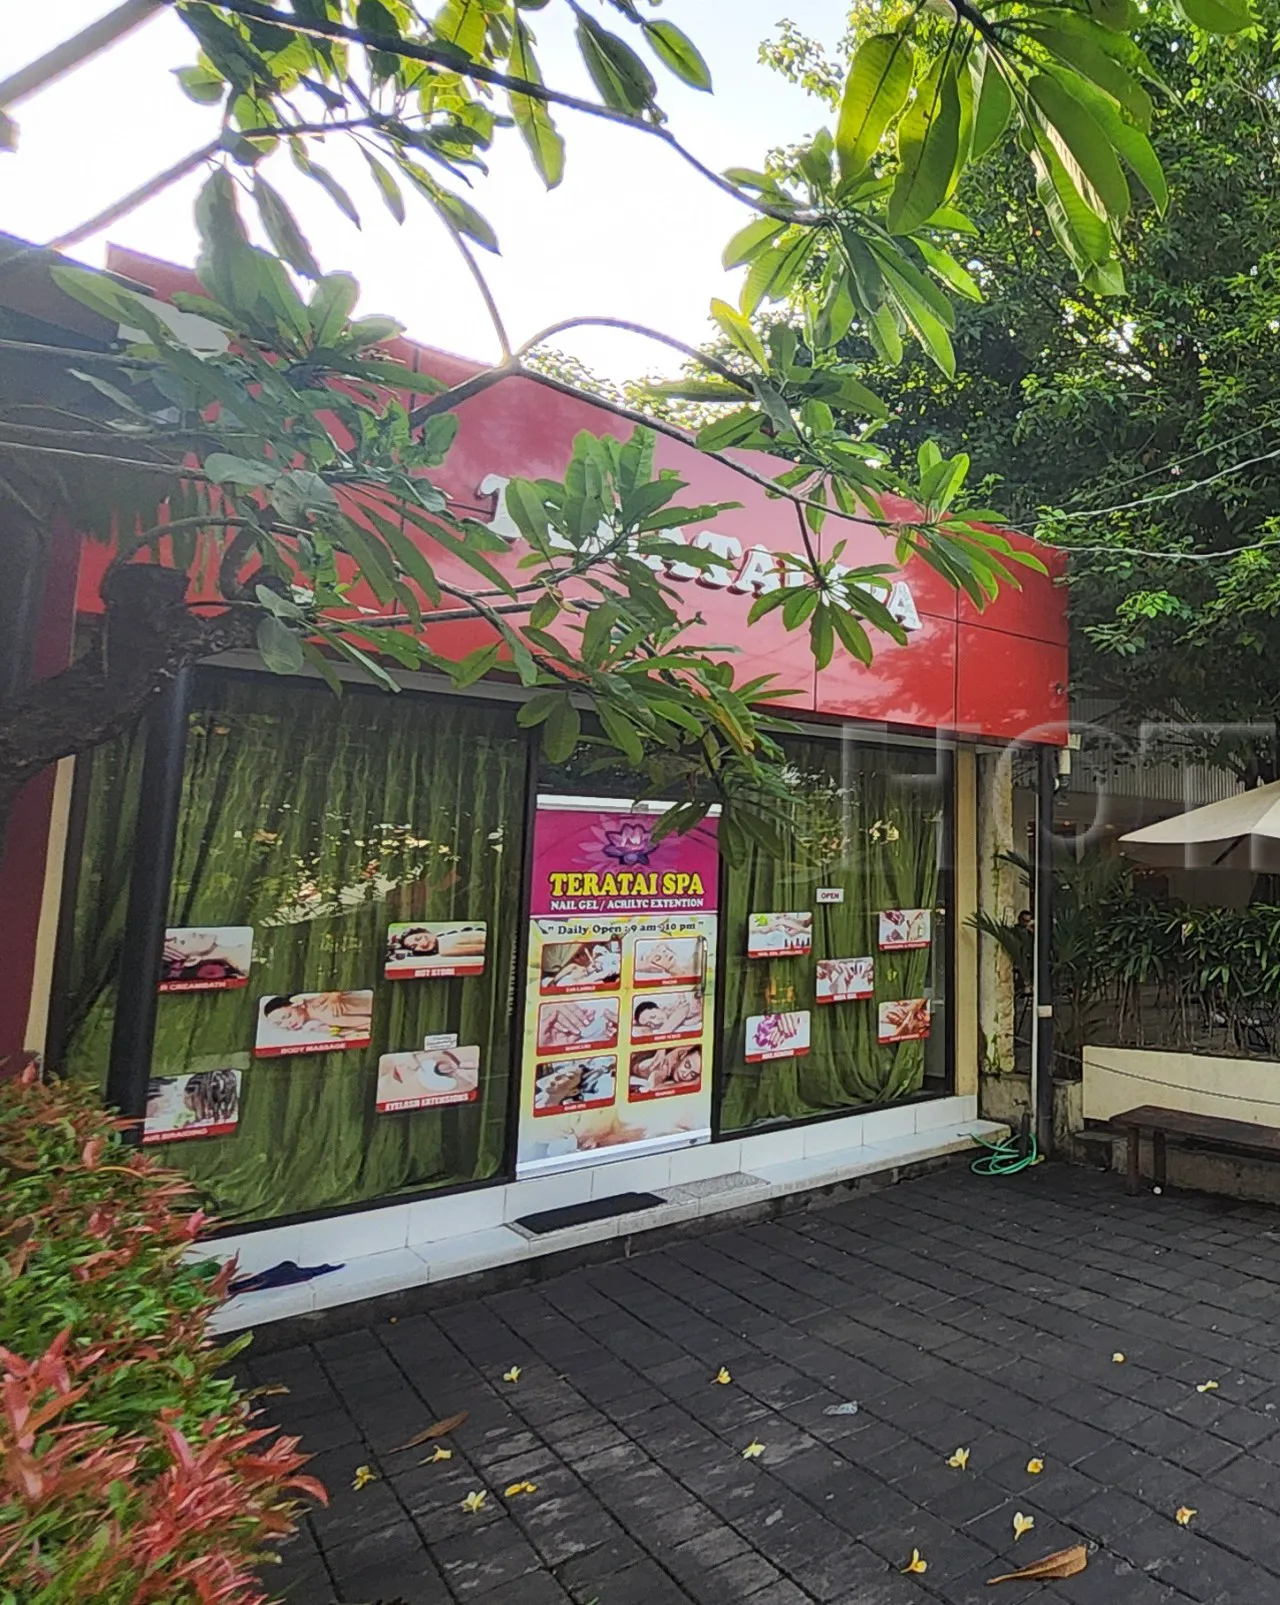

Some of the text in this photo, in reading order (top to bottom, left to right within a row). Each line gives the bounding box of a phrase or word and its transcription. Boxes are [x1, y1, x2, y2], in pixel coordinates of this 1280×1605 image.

[549, 871, 705, 897] TERATAI SPA
[820, 892, 840, 900] OPEN
[551, 900, 577, 911] NAIL
[579, 900, 599, 910] GEL
[650, 898, 704, 909] EXTENTION
[557, 924, 589, 936] Daily
[592, 925, 622, 936] Open
[639, 924, 657, 932] am
[679, 922, 696, 933] pm
